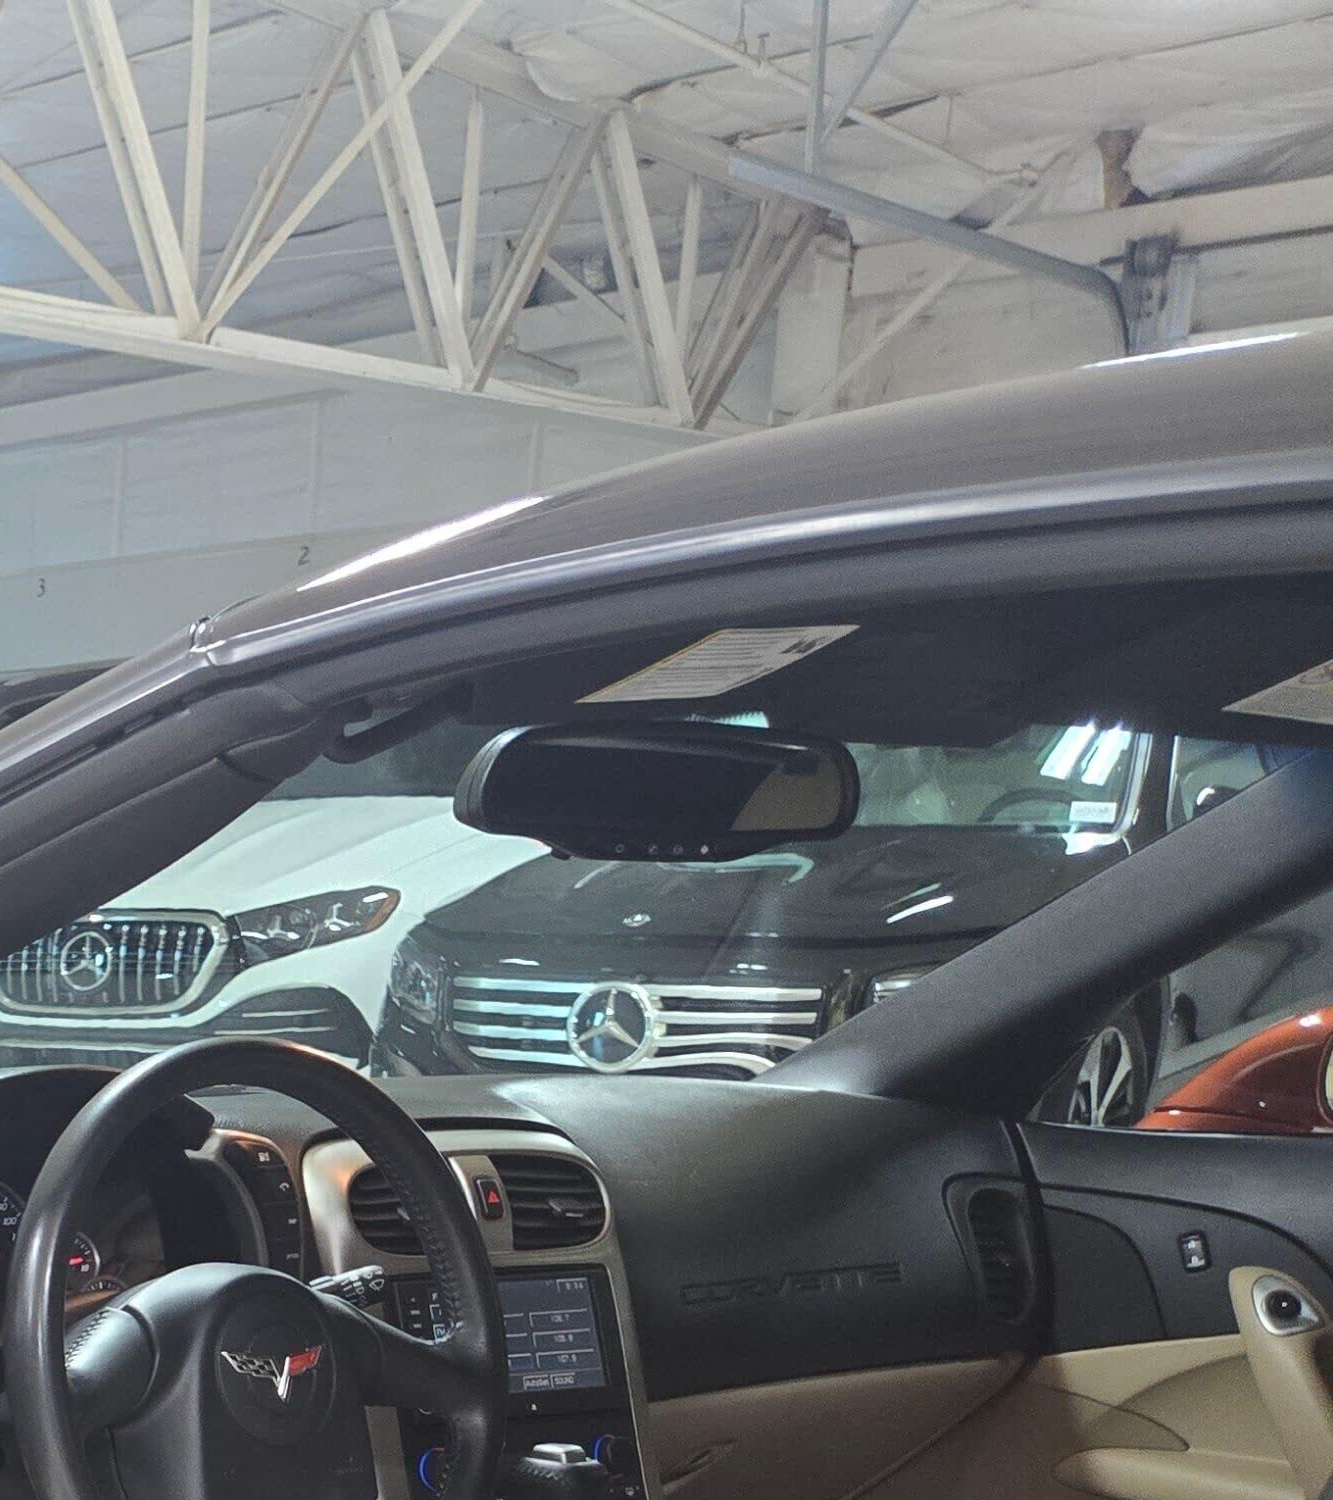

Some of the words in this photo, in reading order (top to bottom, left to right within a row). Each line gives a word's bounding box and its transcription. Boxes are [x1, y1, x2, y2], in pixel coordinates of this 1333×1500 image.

[297, 545, 310, 565] 2
[36, 578, 46, 598] 3
[2, 1216, 18, 1226] 100
[680, 1262, 902, 1306] CORVETTE
